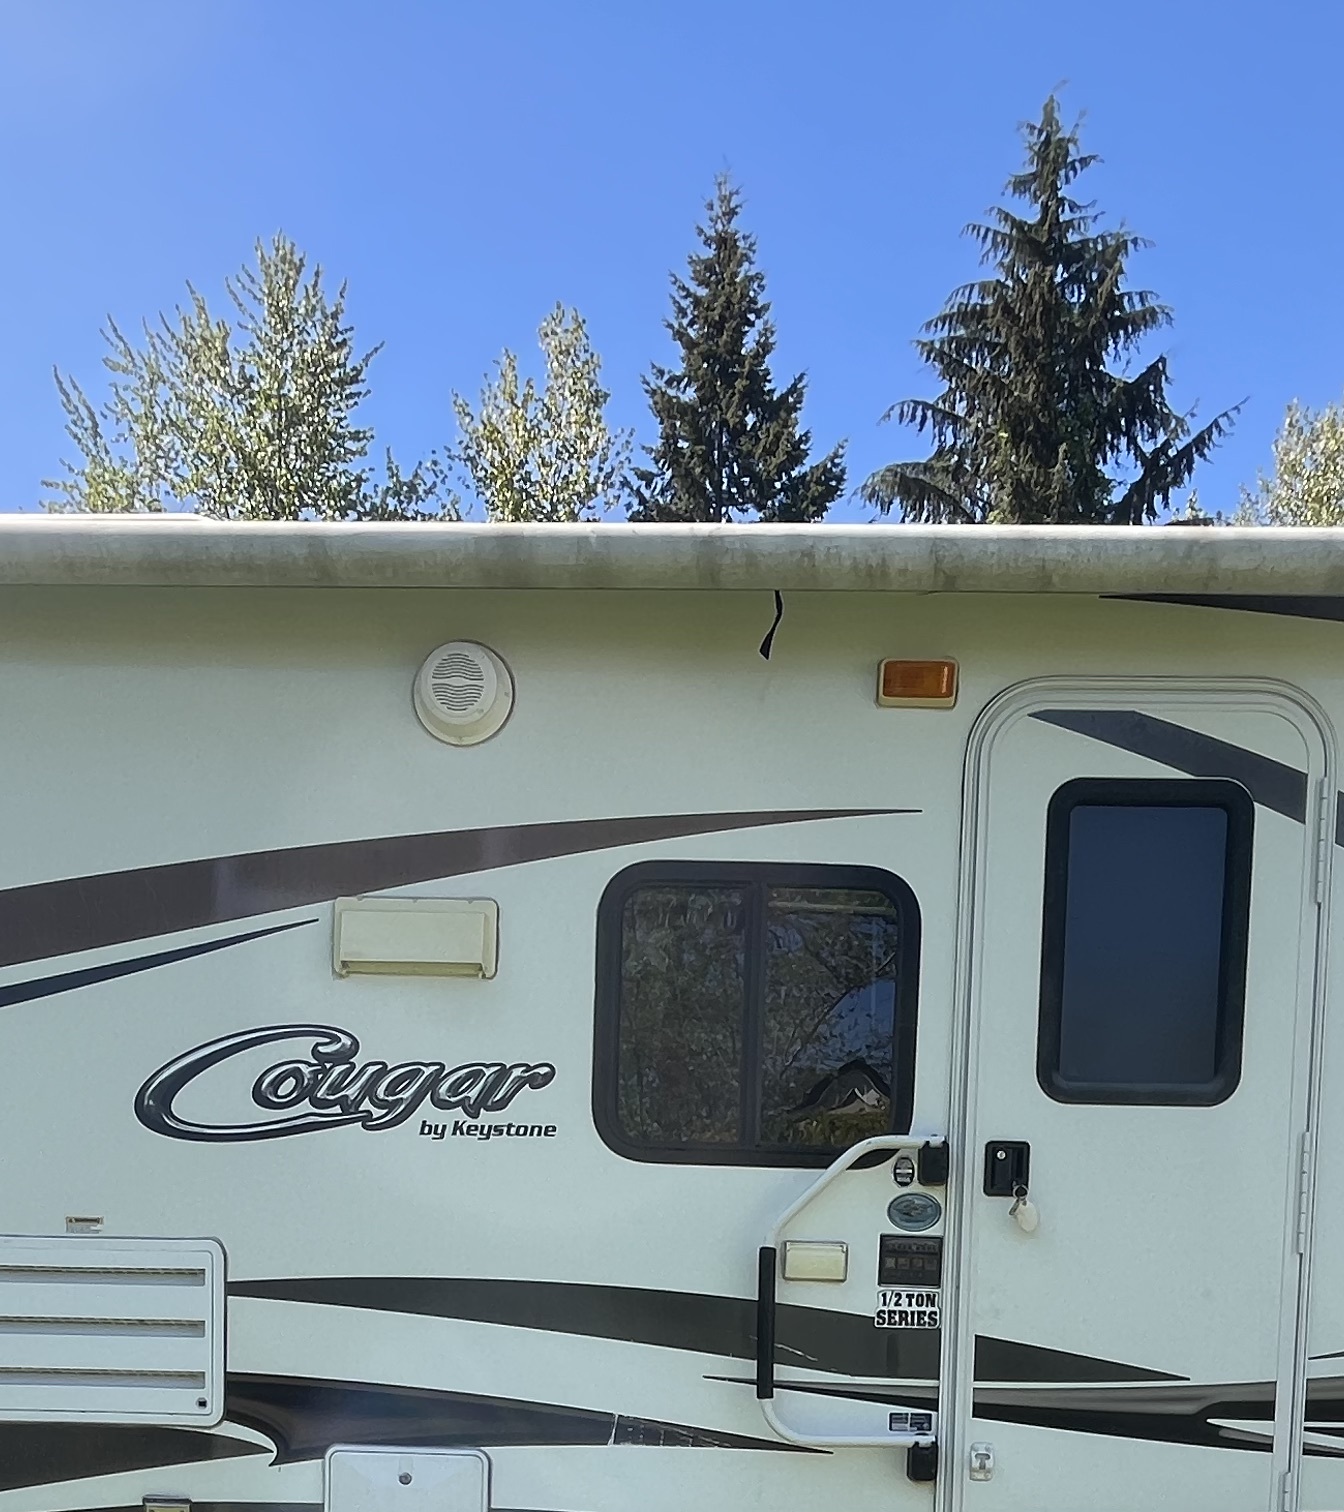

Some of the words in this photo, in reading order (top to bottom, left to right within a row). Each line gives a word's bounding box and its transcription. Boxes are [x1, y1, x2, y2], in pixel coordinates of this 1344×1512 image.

[134, 1023, 557, 1142] Cougar
[419, 1119, 447, 1140] by
[451, 1119, 557, 1140] Keystone
[881, 1291, 903, 1308] 1/2
[905, 1292, 937, 1308] TON
[876, 1309, 938, 1327] SERIES
